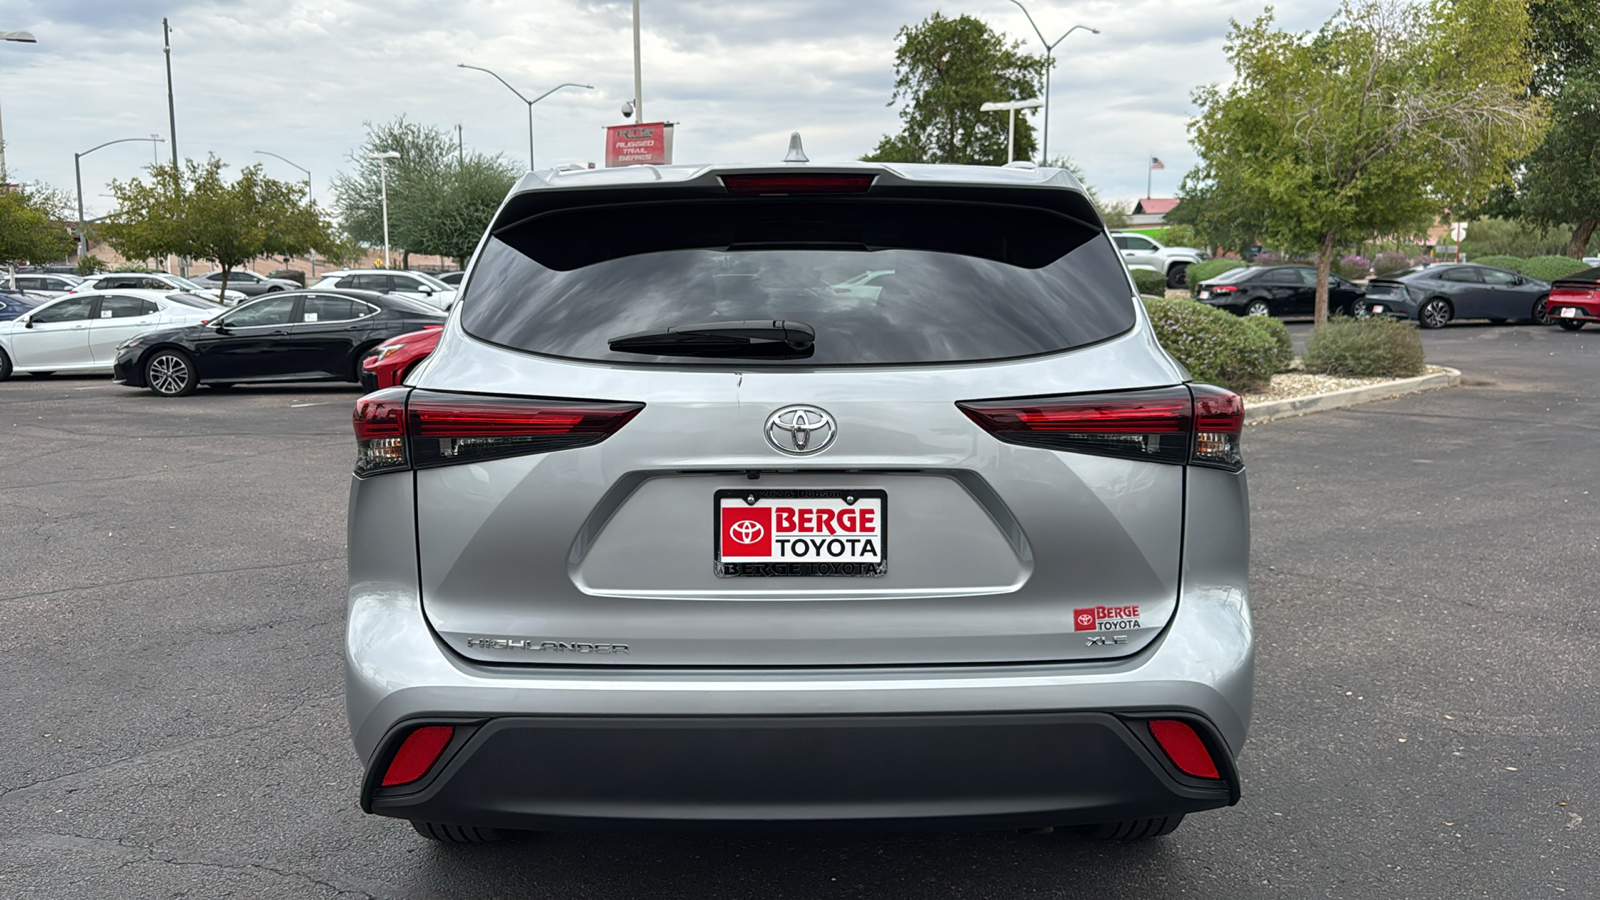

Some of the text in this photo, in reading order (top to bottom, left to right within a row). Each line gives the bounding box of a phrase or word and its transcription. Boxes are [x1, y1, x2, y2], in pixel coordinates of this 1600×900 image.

[616, 140, 654, 148] RUGGED
[775, 507, 876, 536] BERGE
[775, 539, 878, 557] TOYOTA
[724, 563, 878, 576] BERGE TOYOTA
[1095, 605, 1140, 620] BERGE
[1097, 620, 1141, 631] TOYOTA
[467, 637, 630, 654] HIGHLANDER
[1086, 635, 1128, 647] XLE
